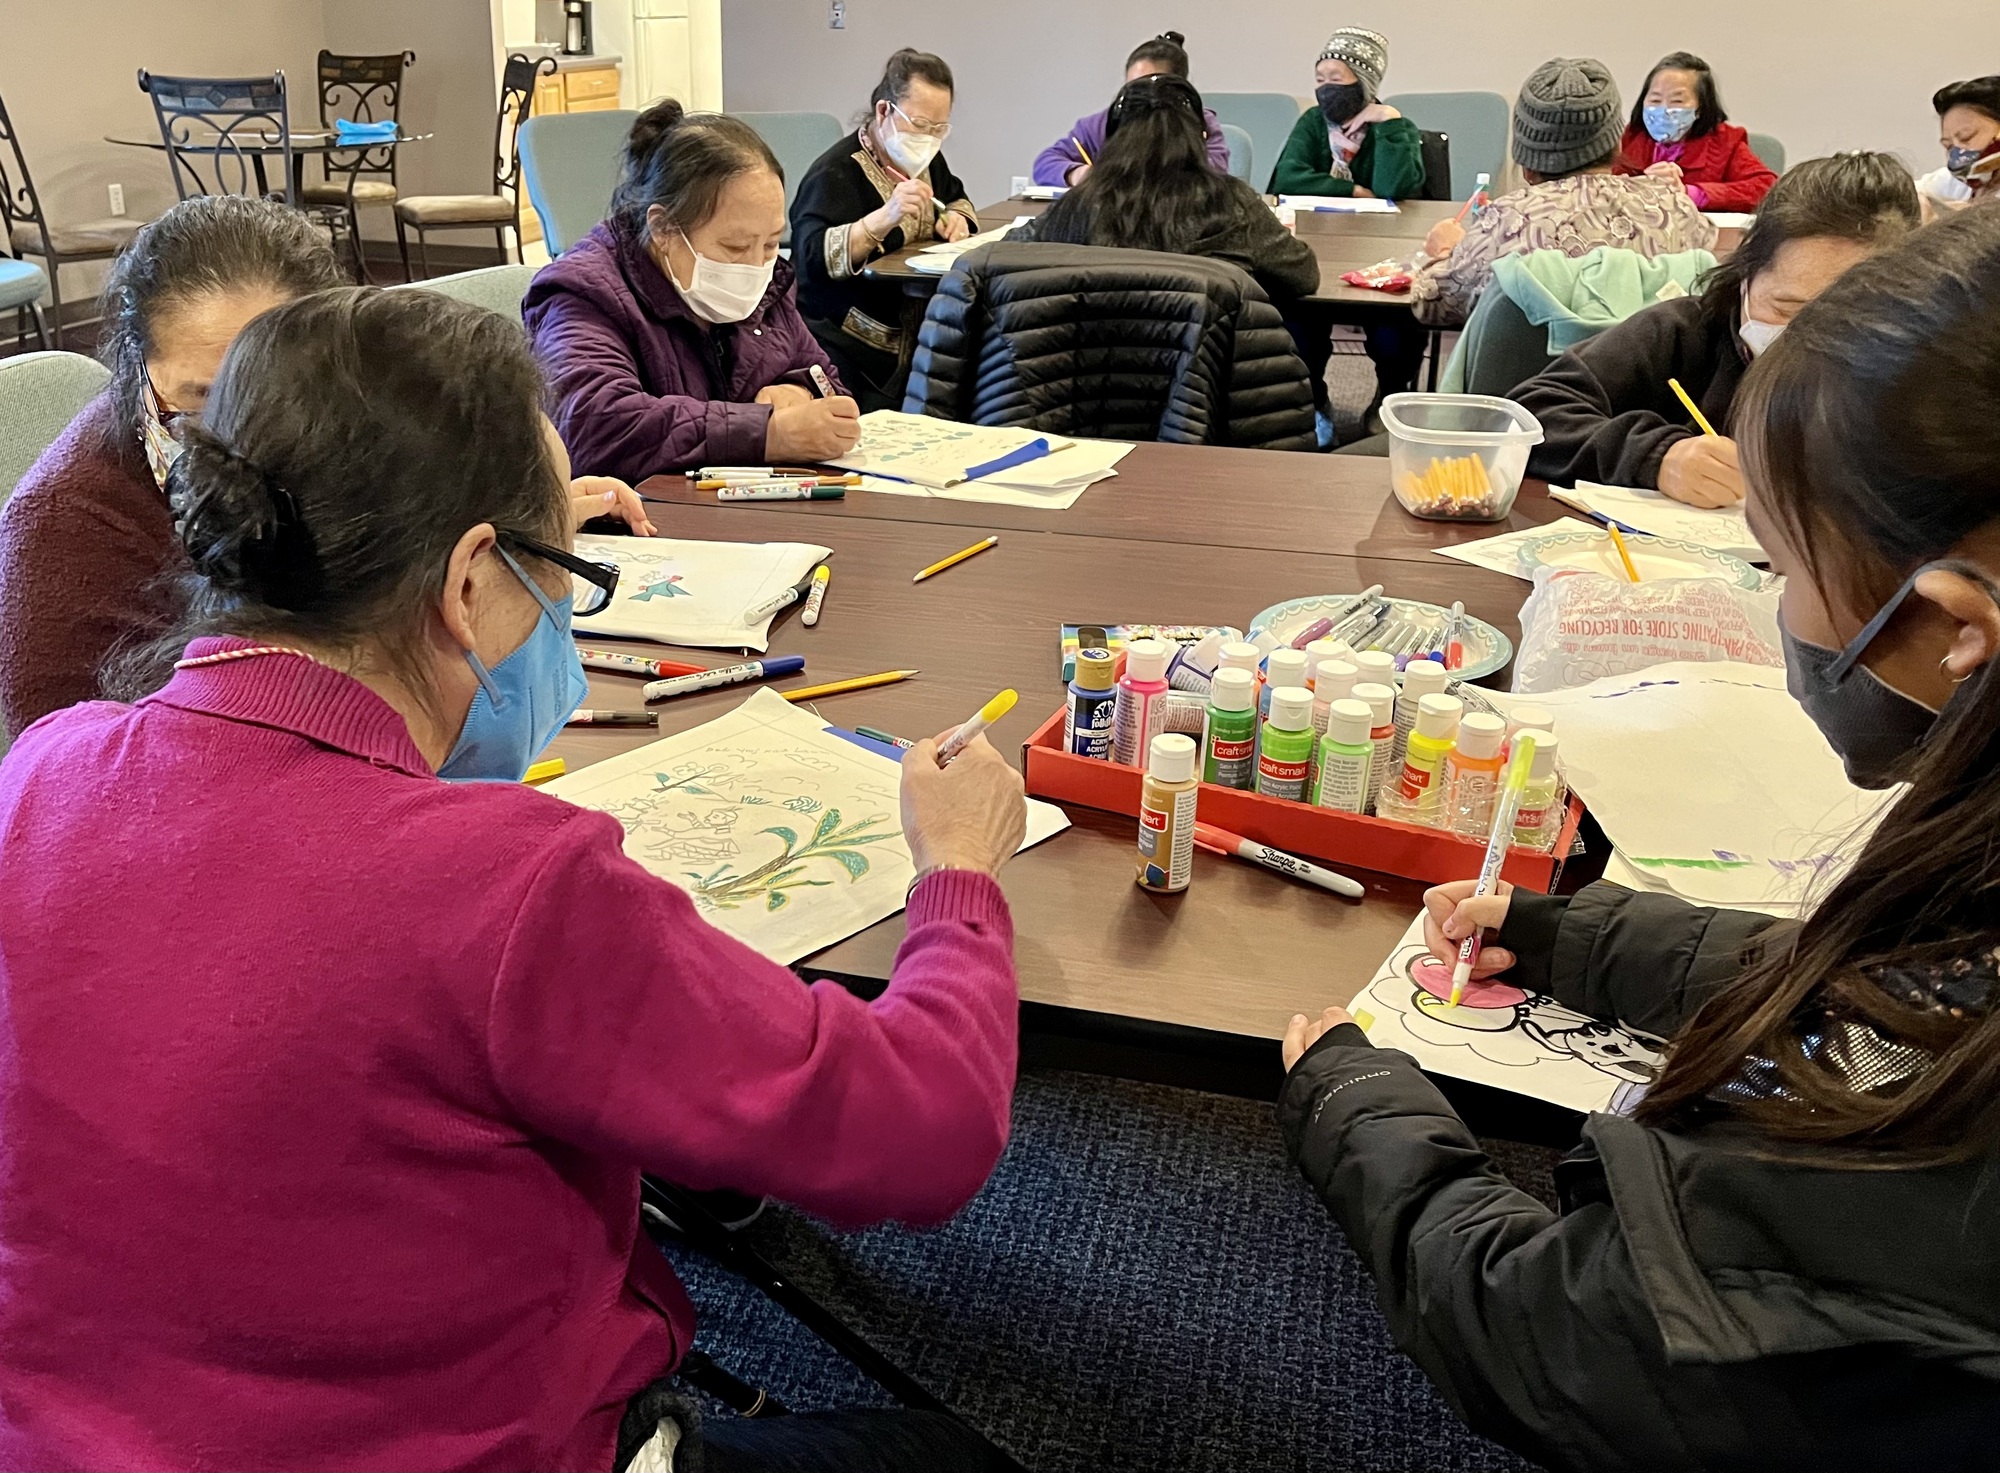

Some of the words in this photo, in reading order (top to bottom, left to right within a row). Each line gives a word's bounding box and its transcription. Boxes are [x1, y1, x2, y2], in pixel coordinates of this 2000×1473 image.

[1558, 618, 1619, 637] RECYCLING
[1621, 619, 1644, 636] FOR
[1646, 619, 1679, 639] STORE
[1216, 745, 1239, 756] craft
[1260, 761, 1278, 775] craft
[1278, 766, 1306, 776] smart
[1403, 767, 1423, 784] mart
[1141, 810, 1159, 827] mart
[1255, 847, 1296, 871] Sharpie
[1314, 1070, 1391, 1124] OMNI-HEAT
